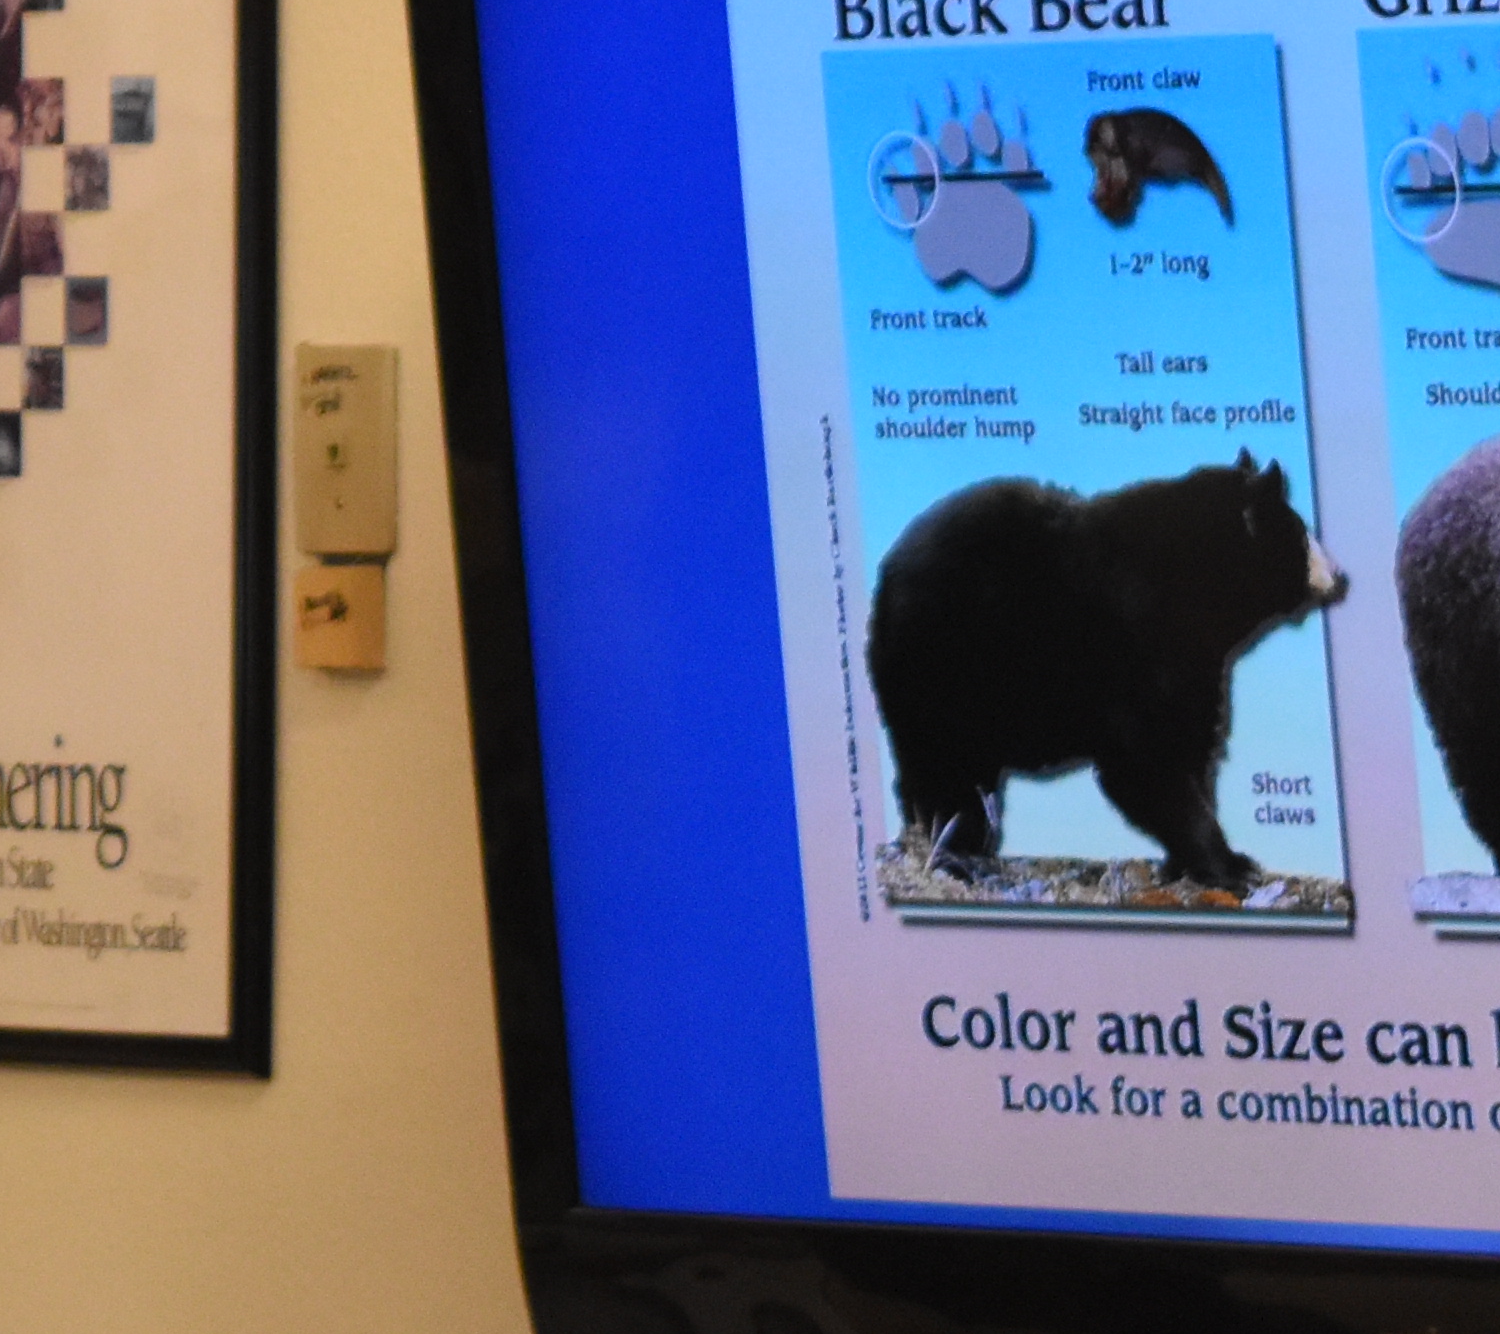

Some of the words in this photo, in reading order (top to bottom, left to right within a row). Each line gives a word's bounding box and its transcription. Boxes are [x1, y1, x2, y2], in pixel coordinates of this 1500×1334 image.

[1087, 69, 1145, 92] Front
[1152, 67, 1201, 90] claw
[1161, 251, 1211, 280] long
[870, 307, 927, 331] Front
[934, 305, 989, 329] track
[1405, 326, 1467, 350] Front
[1115, 351, 1154, 374] Tall
[1162, 354, 1209, 373] ears
[872, 386, 901, 407] No
[907, 384, 1018, 410] prominent
[1079, 401, 1165, 429] Straight
[1171, 400, 1217, 424] face
[1224, 399, 1296, 429] profile
[875, 414, 967, 439] shoulder
[975, 414, 1036, 443] hump
[1251, 771, 1313, 796] Short
[1254, 801, 1316, 826] claws
[921, 992, 1076, 1051] Color
[1097, 1000, 1205, 1058] and
[1223, 1000, 1344, 1062] Size
[1365, 1018, 1473, 1067] can
[1000, 1074, 1098, 1116] Look
[1111, 1075, 1167, 1118] for
[1180, 1088, 1204, 1119] a
[1217, 1085, 1475, 1131] combination
